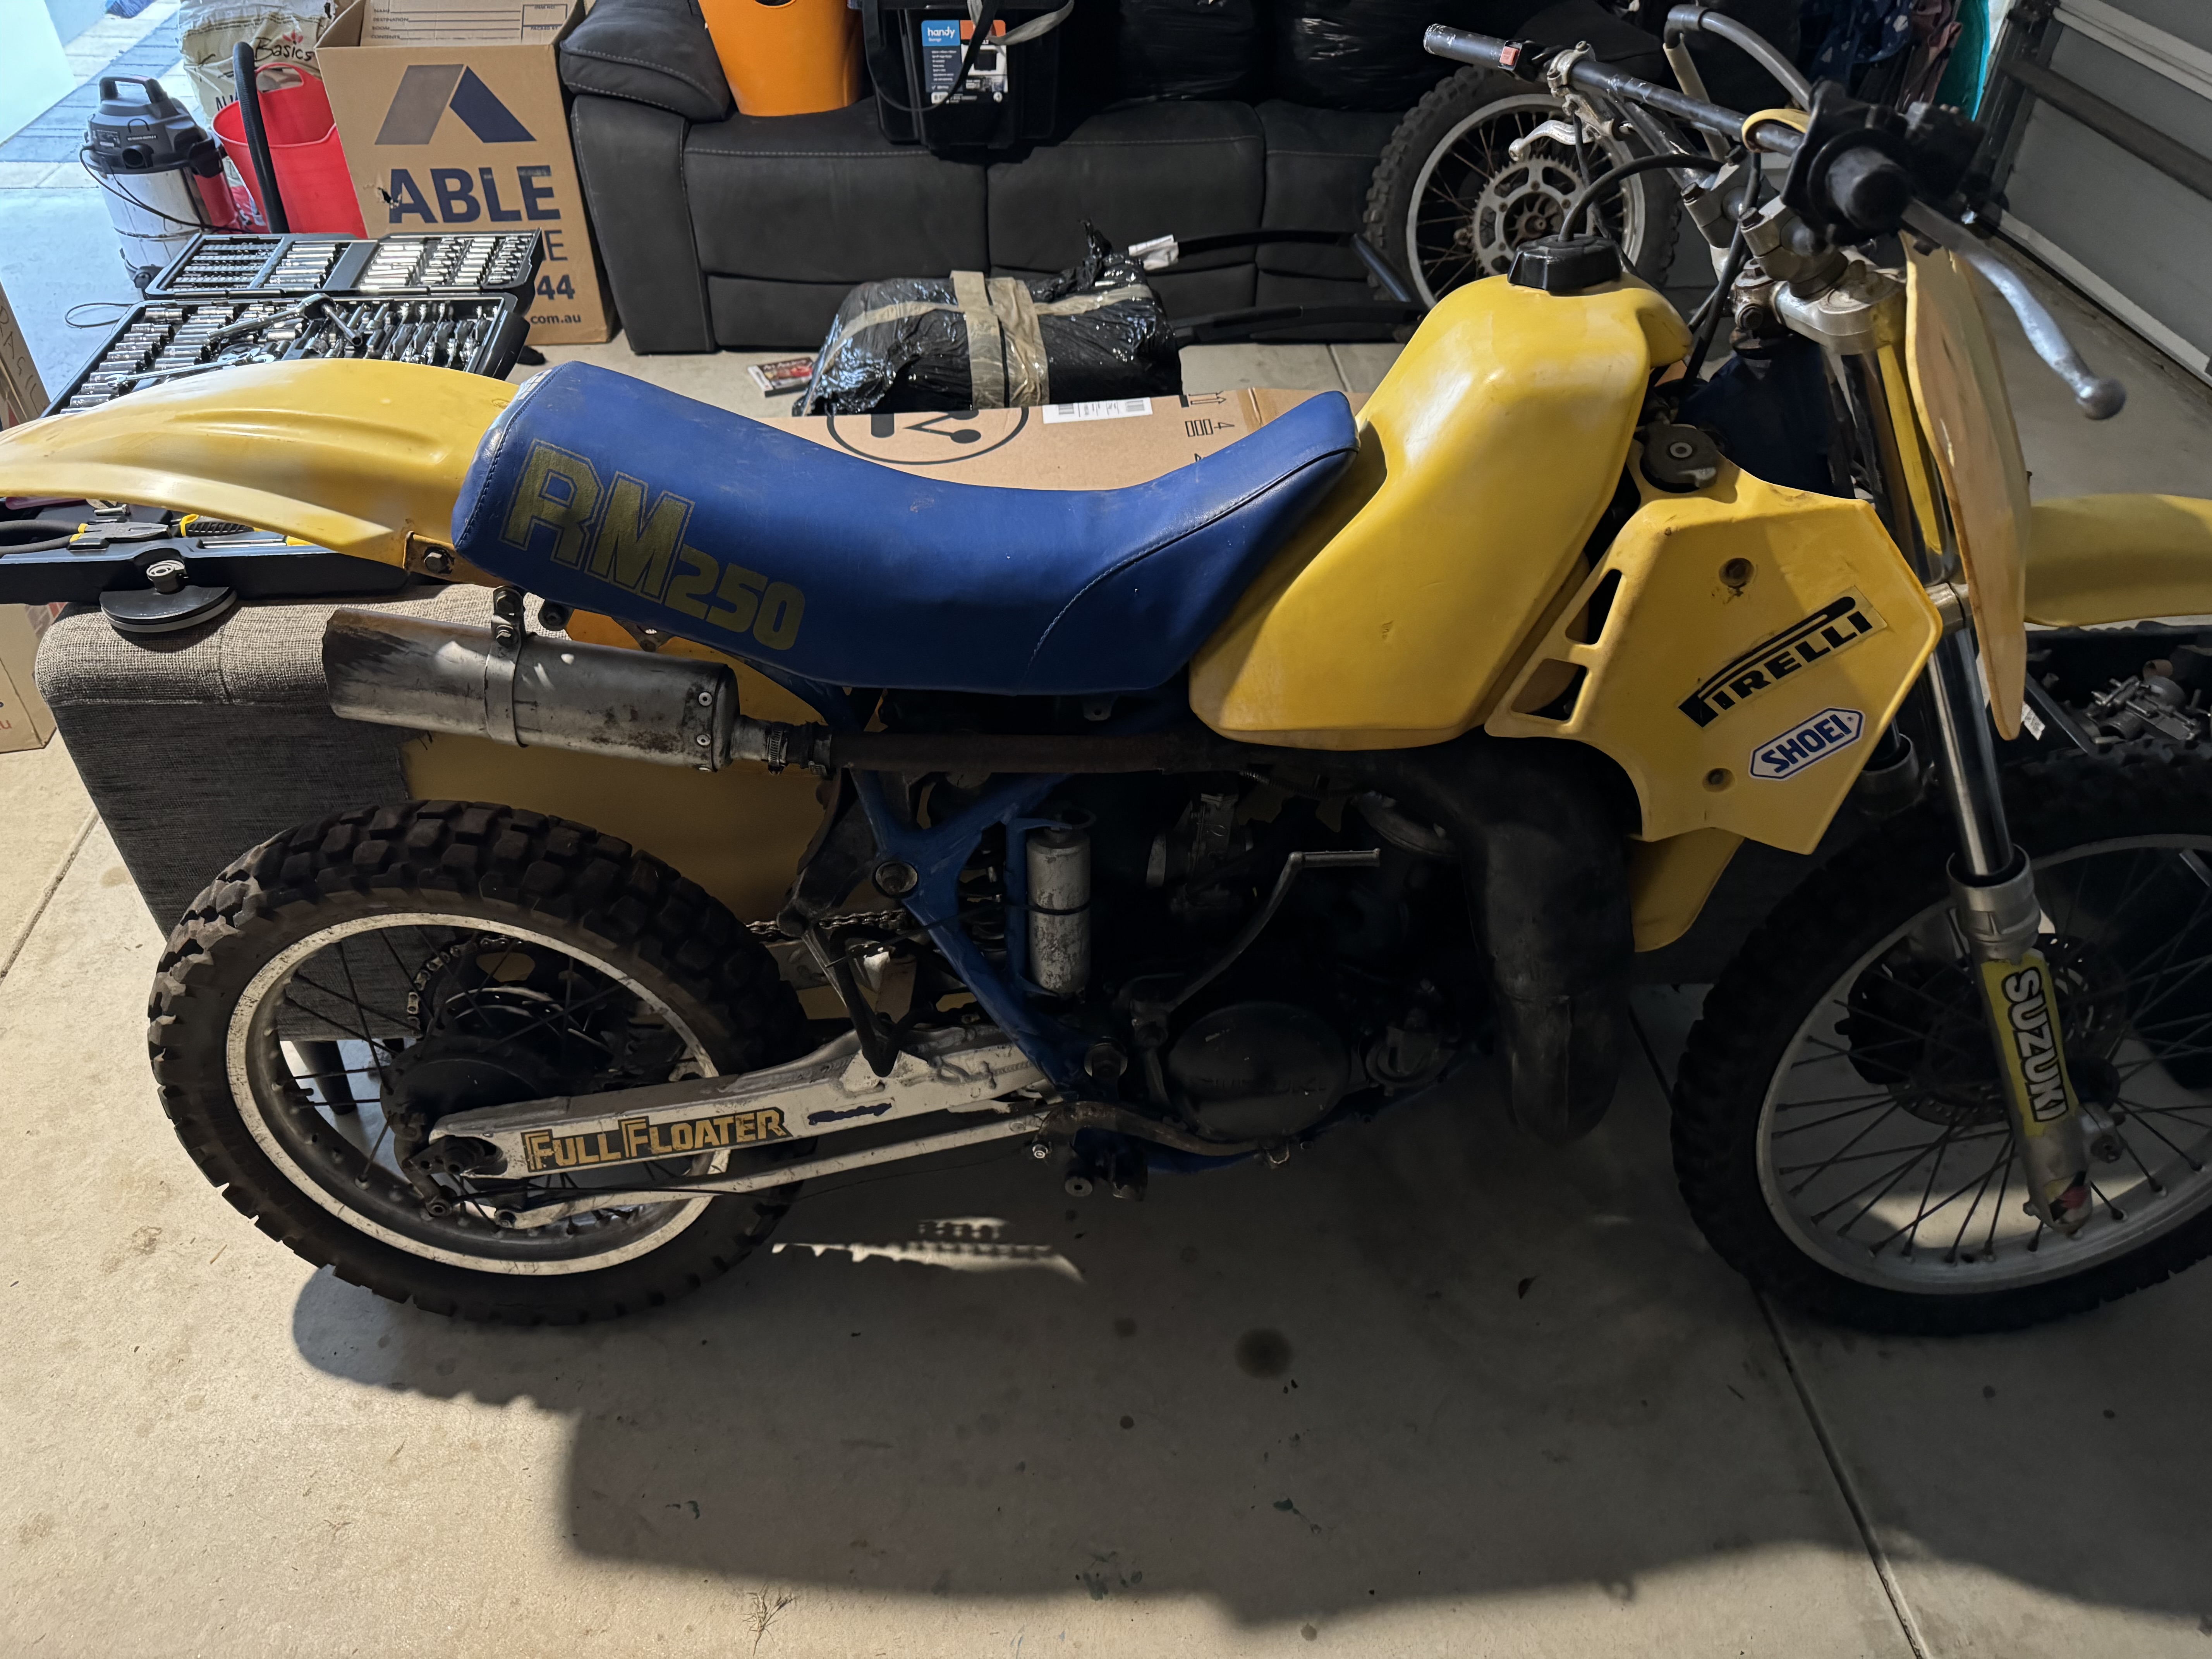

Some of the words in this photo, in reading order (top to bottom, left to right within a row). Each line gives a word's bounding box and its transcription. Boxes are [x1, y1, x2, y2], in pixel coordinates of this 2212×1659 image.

[927, 26, 955, 39] handy
[254, 37, 314, 61] Basics
[388, 165, 561, 224] ABLE
[543, 229, 568, 261] E
[537, 274, 575, 301] 44
[530, 314, 581, 325] com.au
[1678, 596, 1873, 728] PIRELLI
[1761, 714, 1852, 773] SHOEI
[2001, 966, 2069, 1122] SUZUKI
